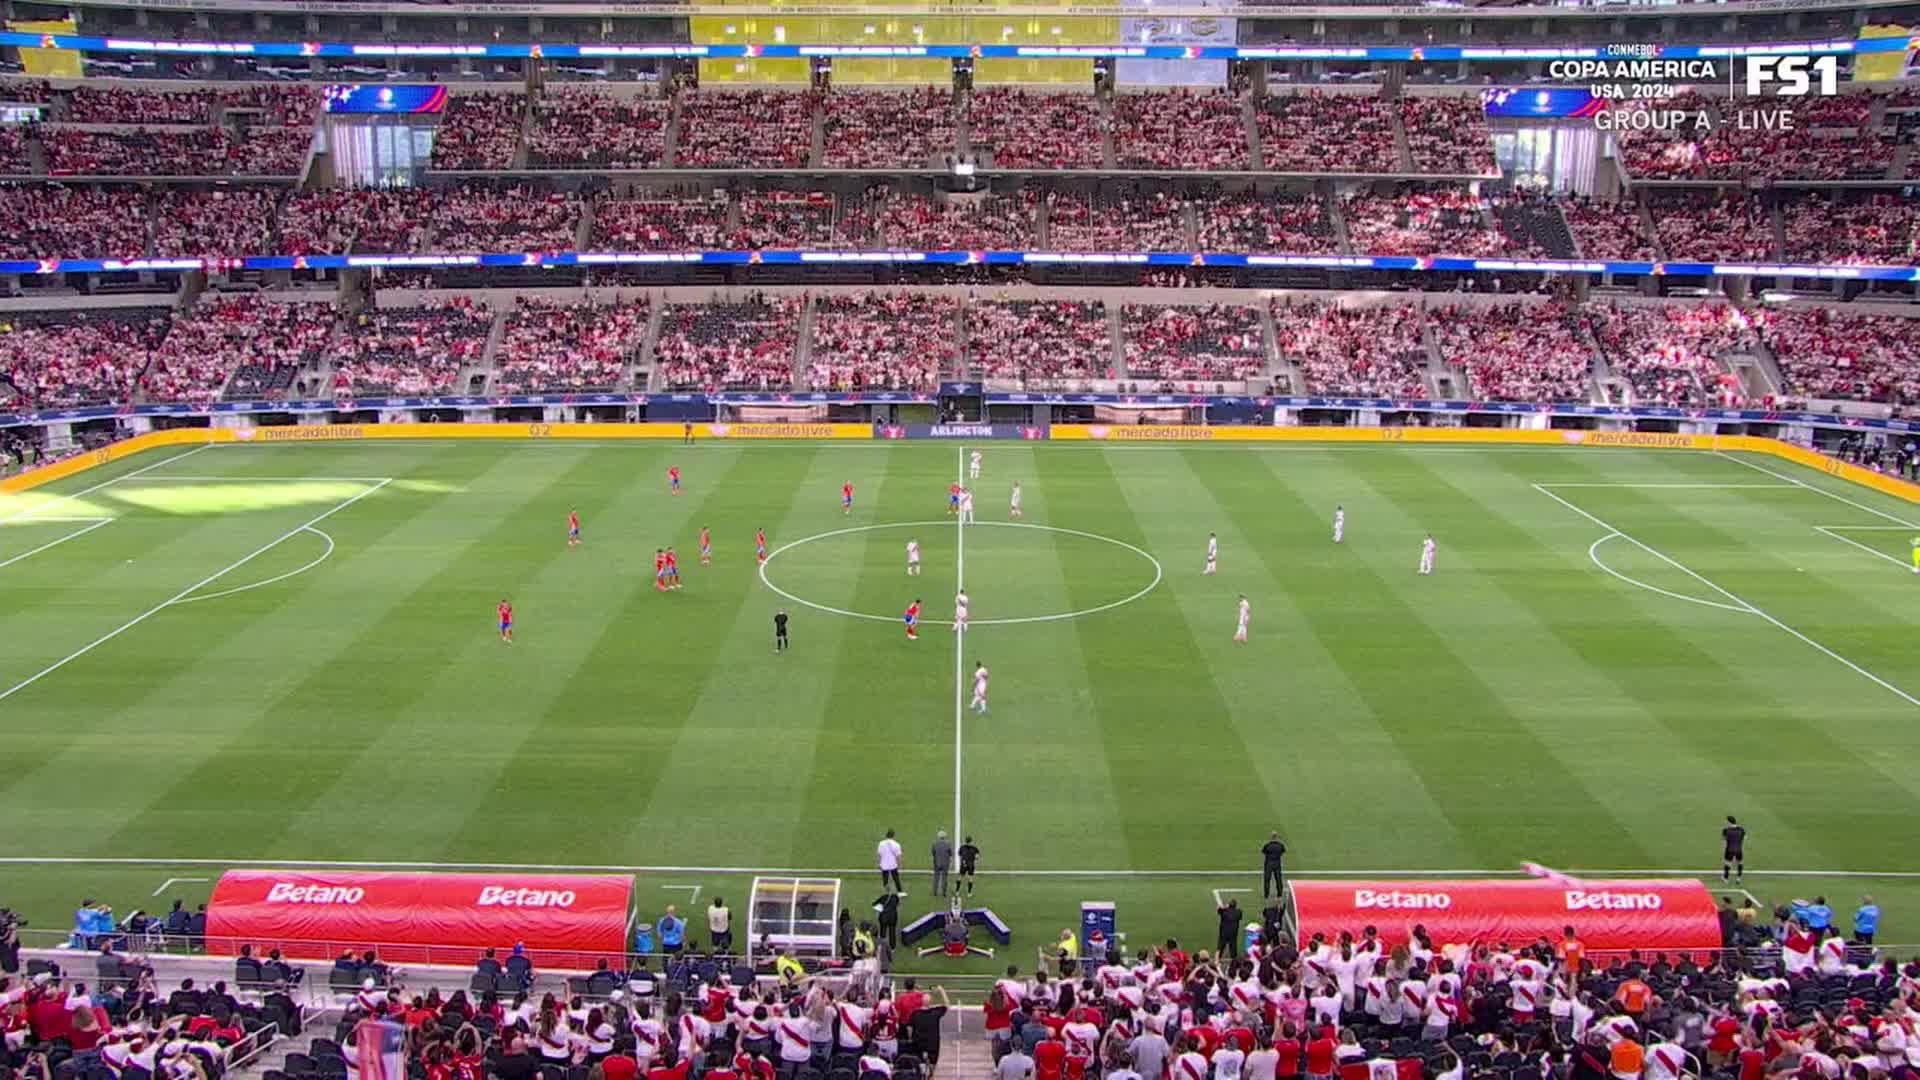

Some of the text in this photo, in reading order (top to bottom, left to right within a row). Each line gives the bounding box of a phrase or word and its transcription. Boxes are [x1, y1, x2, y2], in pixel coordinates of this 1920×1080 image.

[930, 425, 992, 437] ARLINGTON
[266, 882, 364, 904] Betano
[477, 886, 576, 908] Betano
[1355, 889, 1451, 909] Betano
[1566, 890, 1662, 910] Betano
